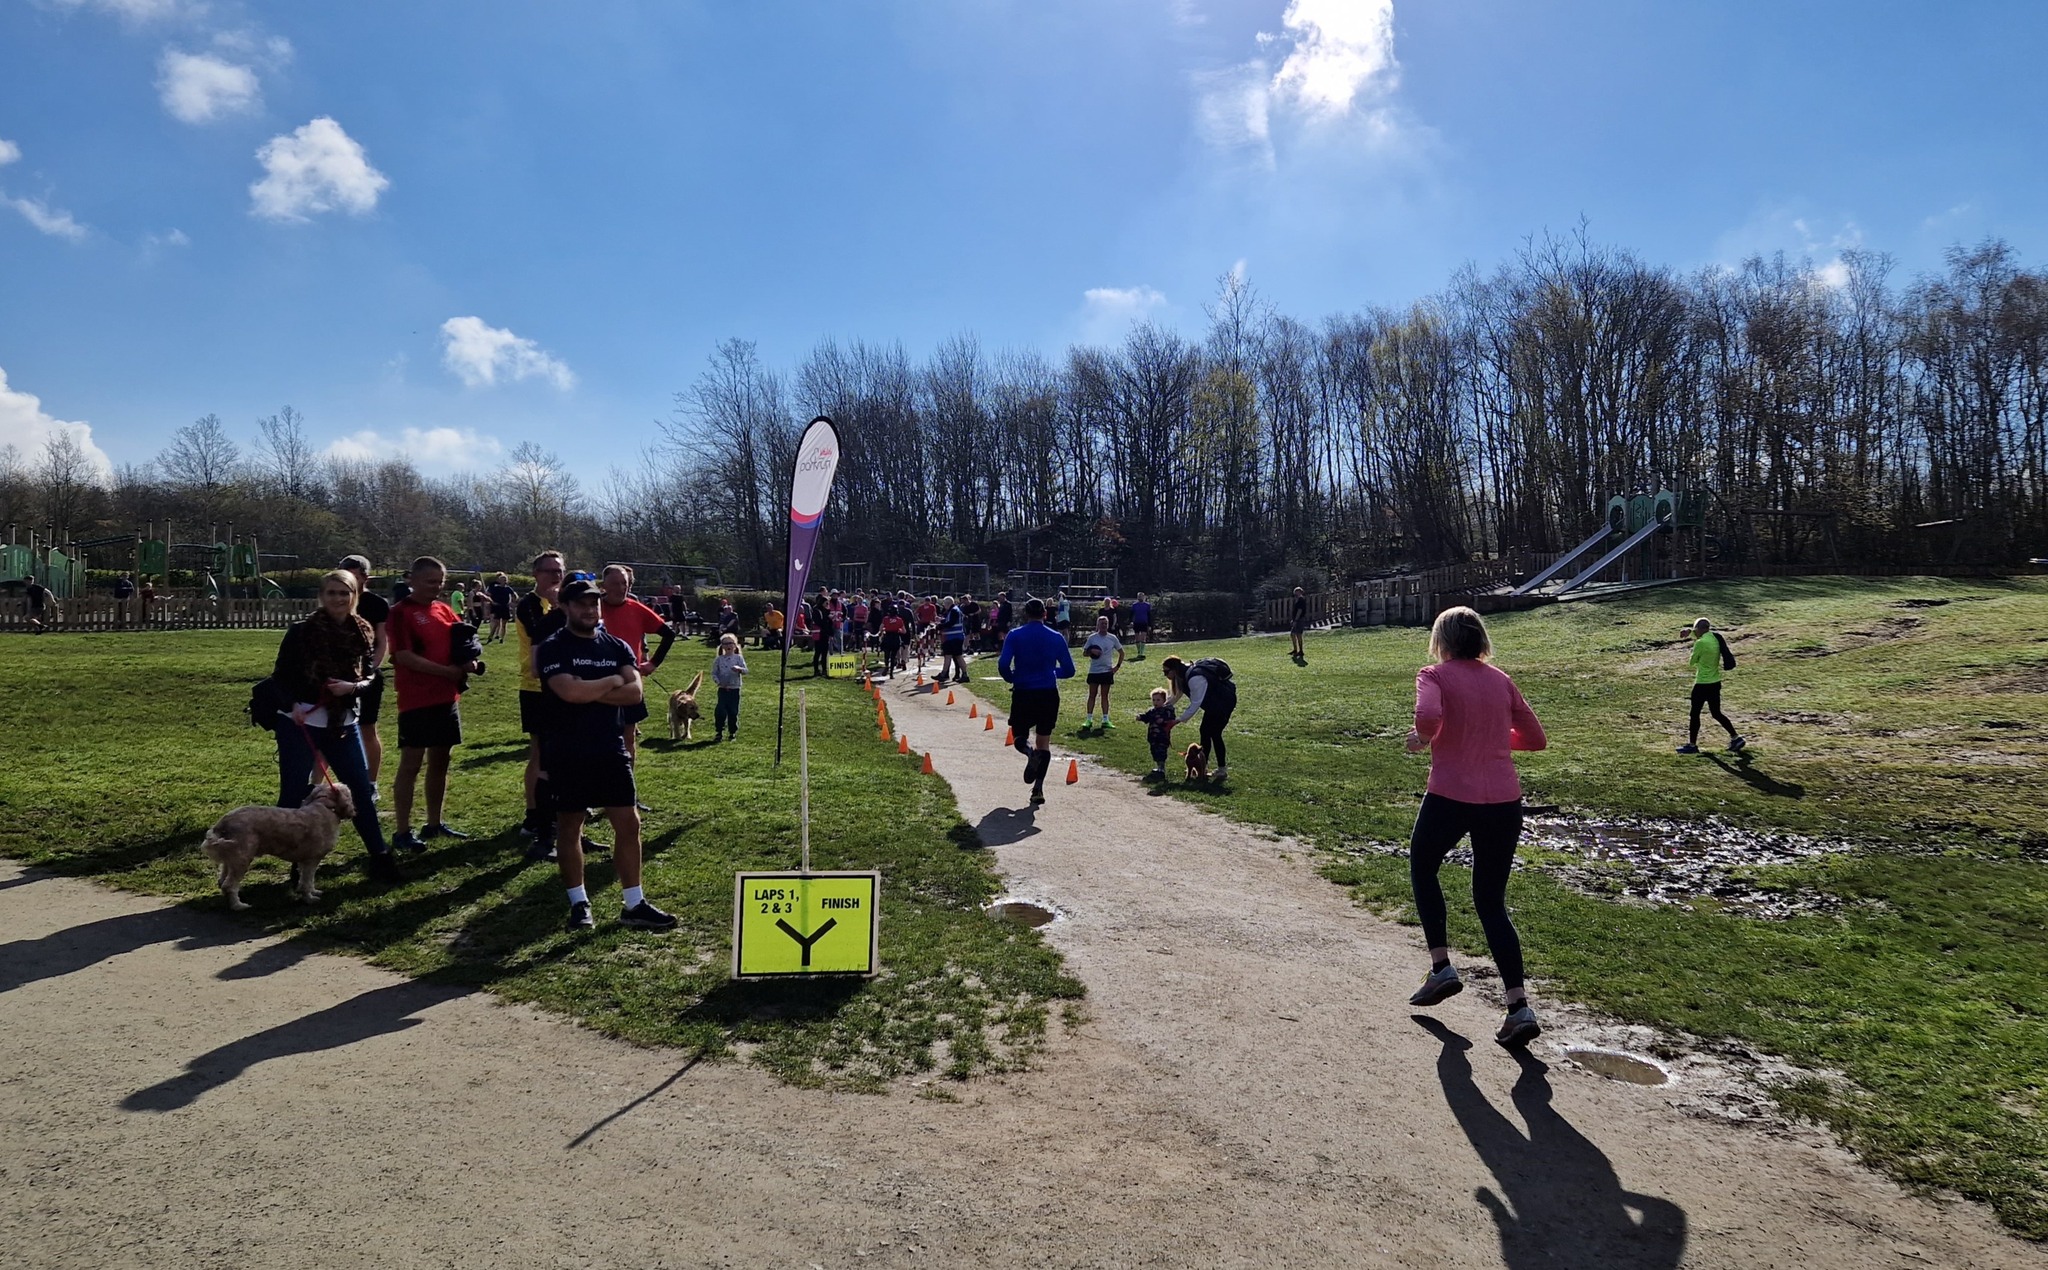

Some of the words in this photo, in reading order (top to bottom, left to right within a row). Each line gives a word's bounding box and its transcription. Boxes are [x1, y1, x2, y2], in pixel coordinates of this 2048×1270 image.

[829, 661, 854, 670] FINISH
[754, 889, 785, 901] LAPS
[789, 889, 800, 903] 1,
[760, 902, 769, 914] 2
[771, 902, 781, 914] &
[784, 902, 793, 914] 3
[821, 898, 860, 909] FINISH
